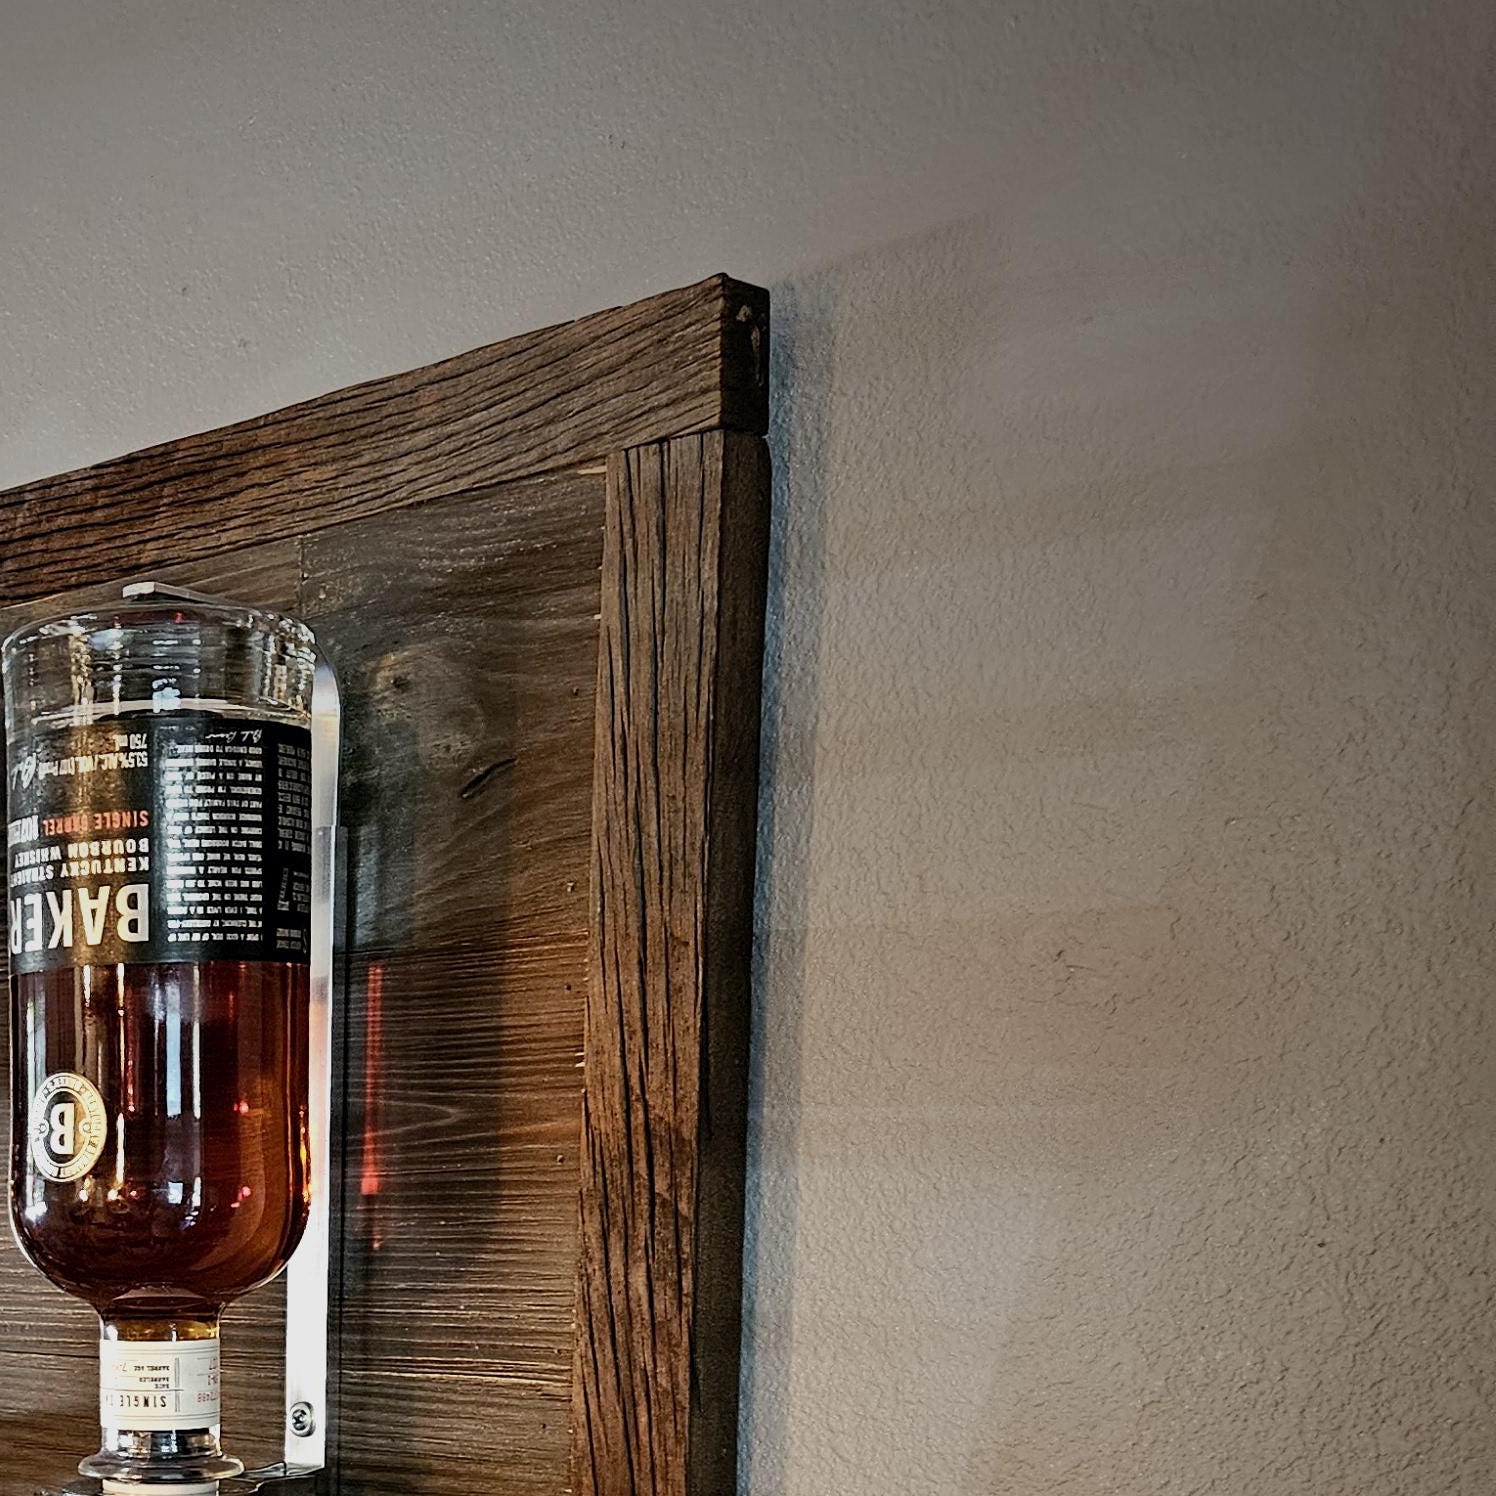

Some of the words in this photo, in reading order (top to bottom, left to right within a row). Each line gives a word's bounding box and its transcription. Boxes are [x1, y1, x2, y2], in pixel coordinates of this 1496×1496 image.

[42, 814, 89, 836] BARREL
[93, 810, 150, 830] SINGLE
[14, 846, 62, 868] WHISKEY
[67, 838, 150, 859] BOURBON
[59, 857, 150, 878] KENTUCKY
[50, 1102, 75, 1155] B
[119, 1395, 168, 1408] SINGLE
